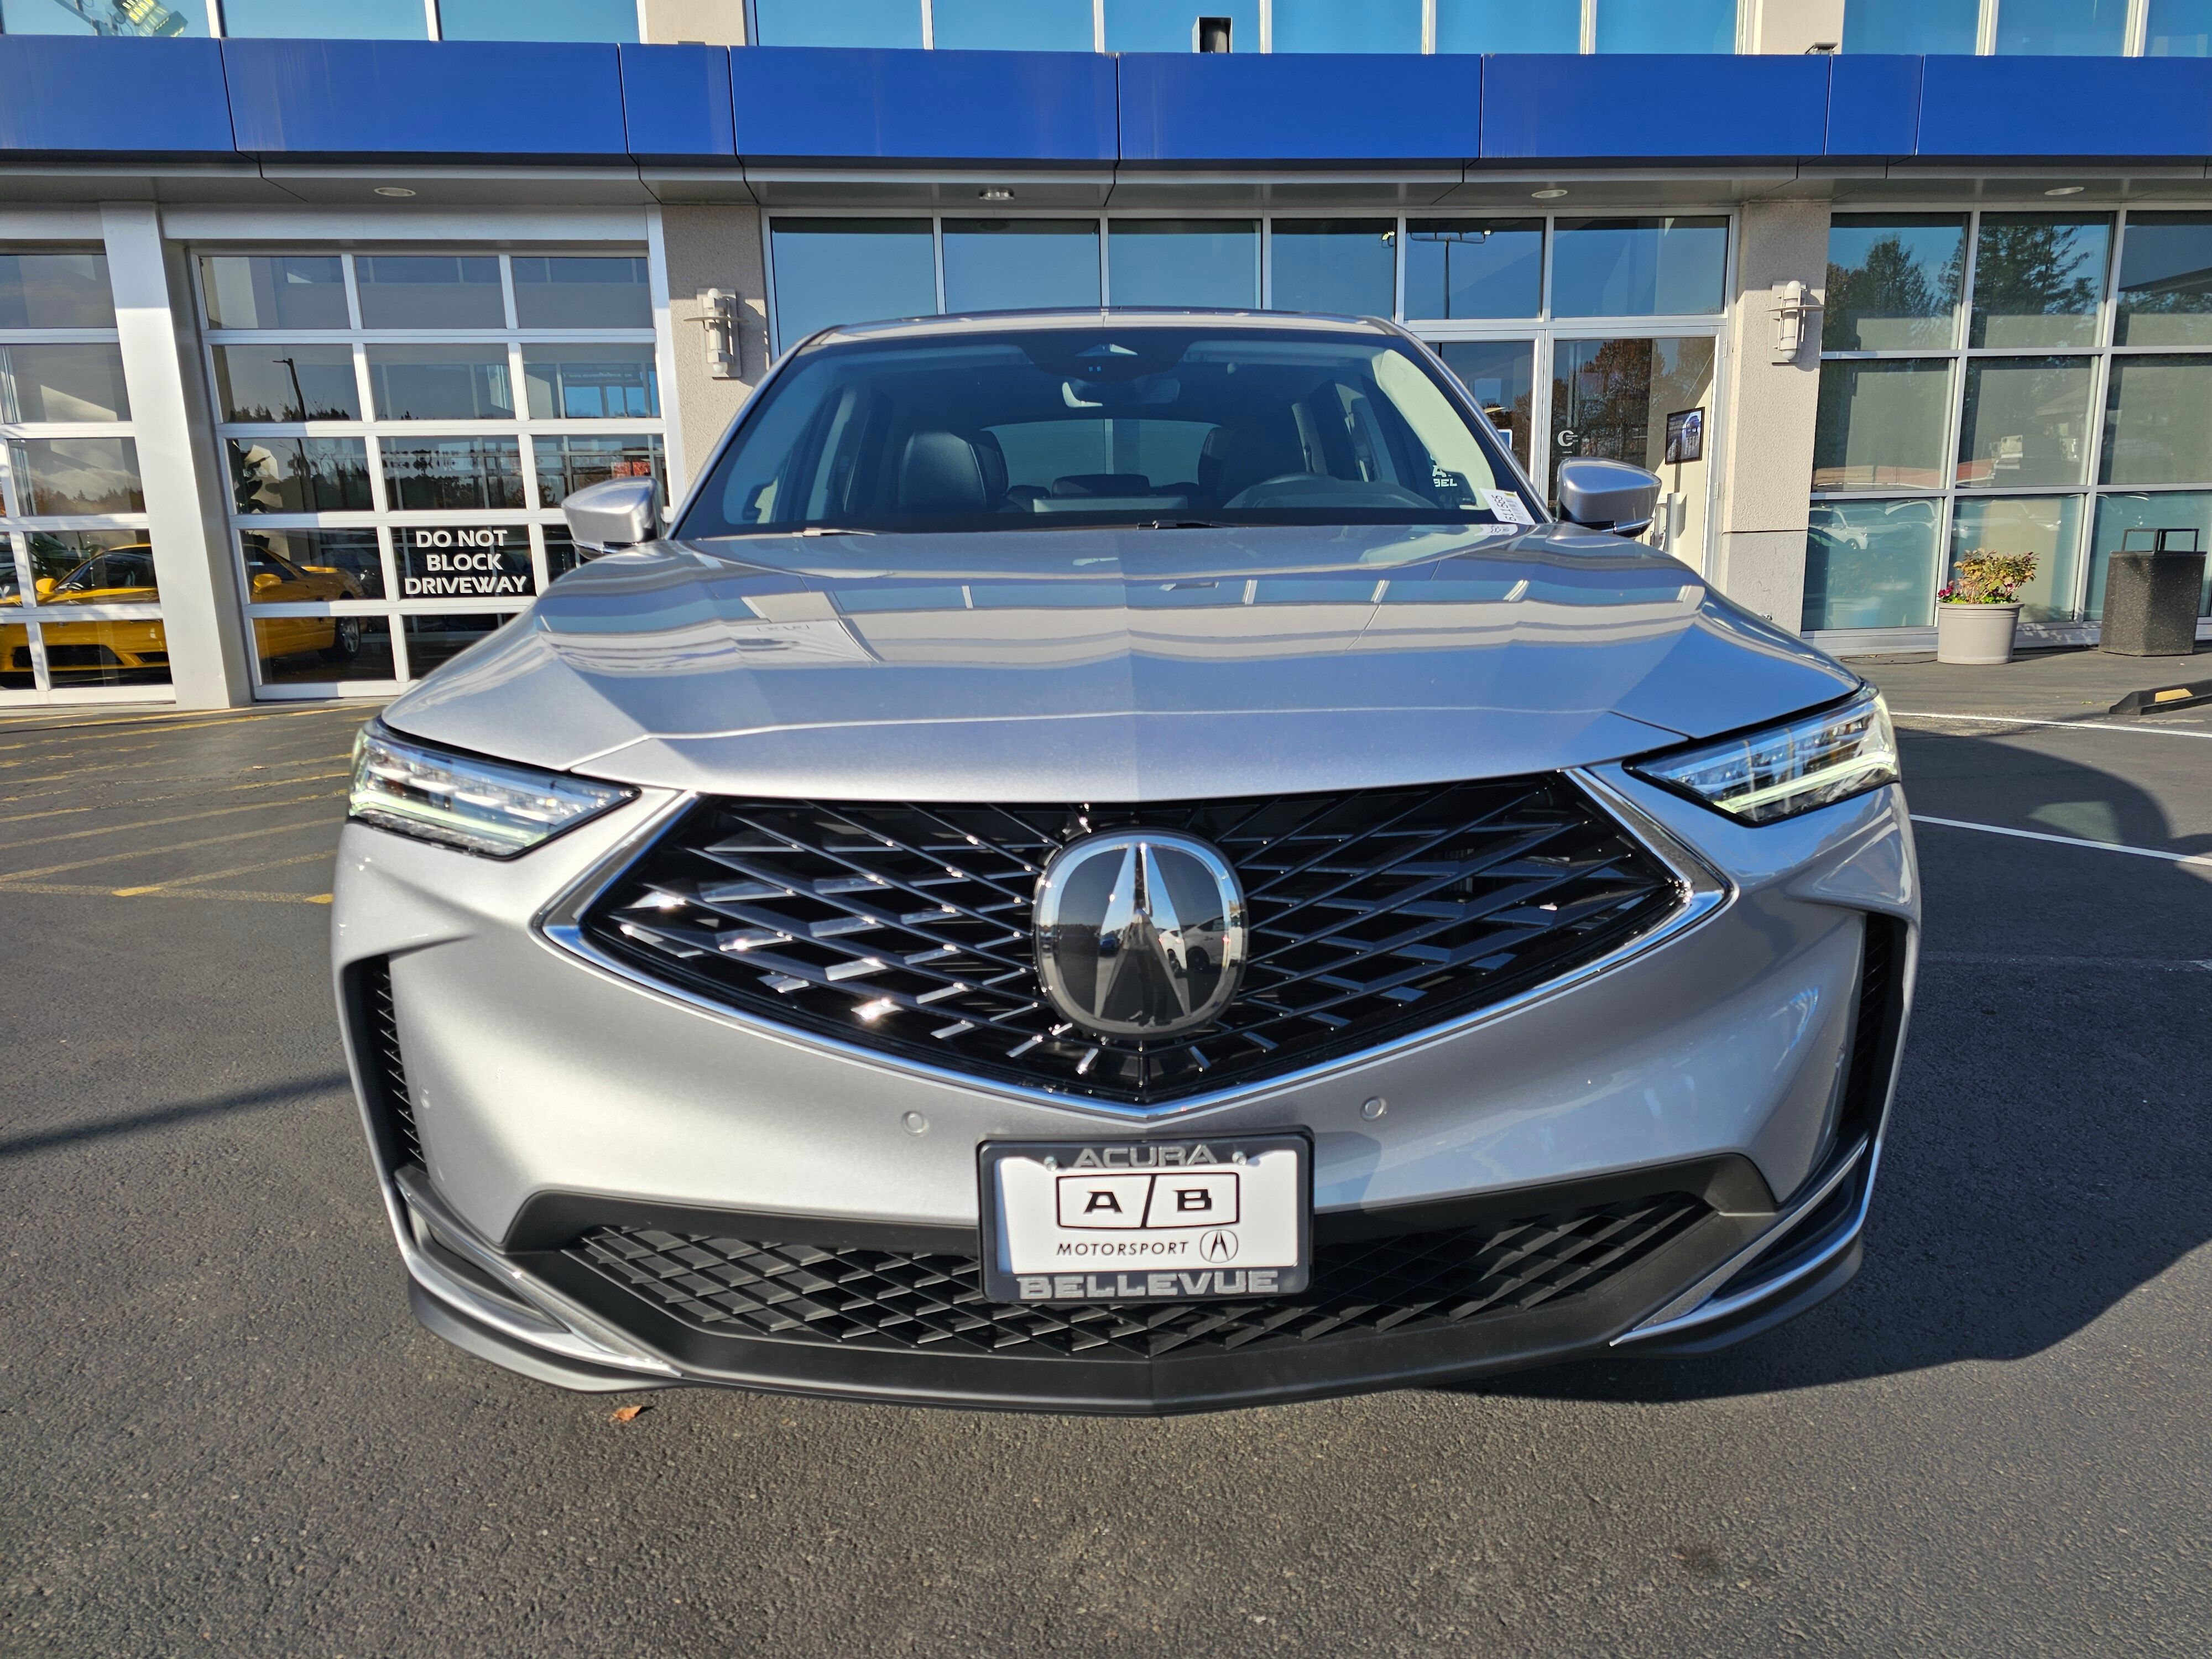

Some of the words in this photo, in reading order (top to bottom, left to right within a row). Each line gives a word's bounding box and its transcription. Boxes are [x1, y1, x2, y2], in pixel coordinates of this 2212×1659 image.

[416, 530, 452, 547] DO
[457, 529, 508, 547] NOT
[426, 554, 503, 571] BLOCK
[404, 575, 526, 594] DRIVEWAY
[1075, 1145, 1217, 1168] ACURA
[1056, 1241, 1190, 1256] MOTORSPORT
[1016, 1271, 1279, 1300] BELLEVUE
